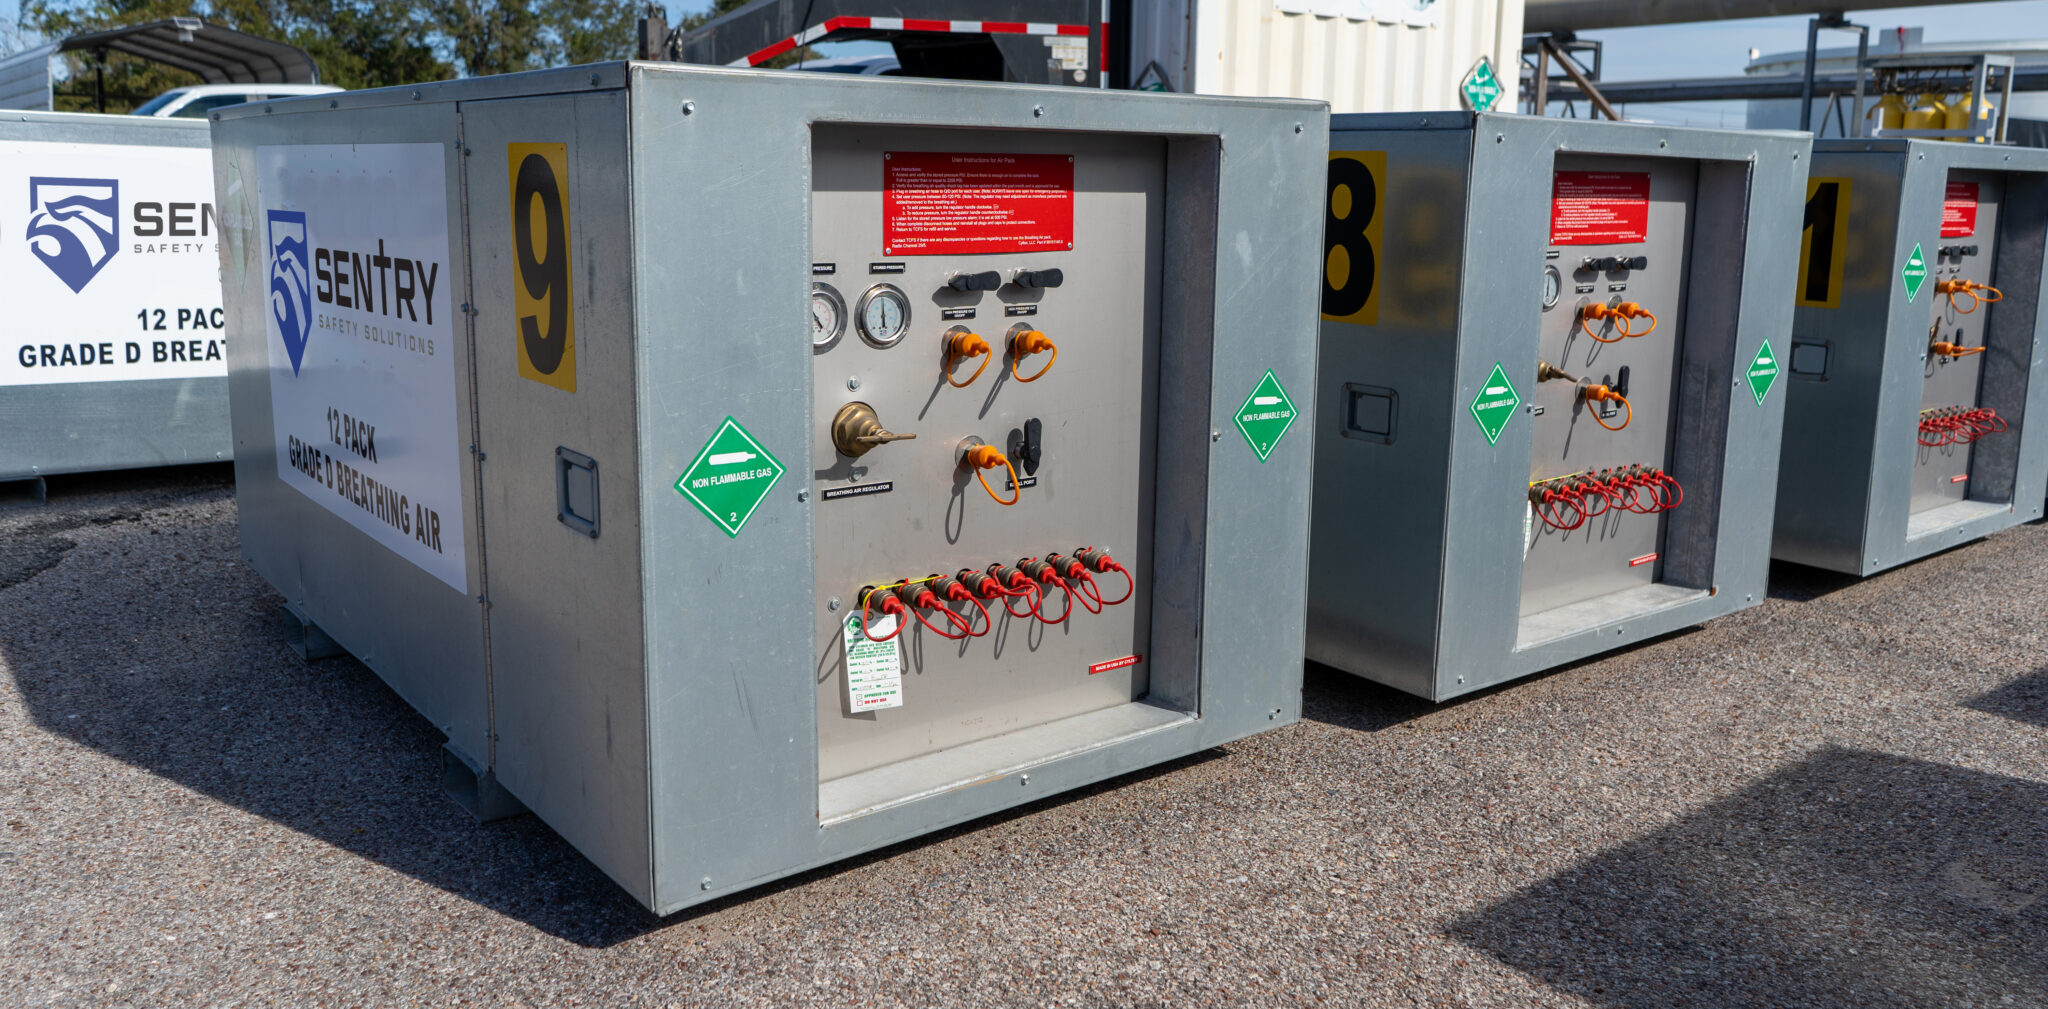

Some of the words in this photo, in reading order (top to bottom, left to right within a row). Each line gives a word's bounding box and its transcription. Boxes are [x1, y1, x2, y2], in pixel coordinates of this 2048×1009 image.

[134, 244, 203, 255] SAFETY
[1320, 157, 1376, 316] 8
[1803, 182, 1839, 302] 1
[514, 153, 568, 375] 9
[315, 239, 438, 325] SENTRY
[138, 308, 167, 331] 12
[178, 308, 224, 330] PAC
[319, 314, 358, 336] SAFETY
[364, 325, 434, 357] SOLUTIONS
[19, 342, 114, 368] GRADE
[126, 342, 141, 364] D
[1254, 411, 1280, 420] FLAMMABLE
[1281, 410, 1290, 418] GAS
[1486, 400, 1506, 409] FLAMMABLE
[1507, 398, 1515, 406] GAS
[327, 406, 341, 446] 12
[344, 413, 378, 464] PACK
[693, 478, 709, 488] NON
[711, 470, 755, 486] FLAMMABLE
[756, 467, 772, 478] GAS
[289, 434, 323, 484] GRADE
[325, 454, 334, 489] D
[336, 460, 410, 535] BREATHING
[416, 503, 442, 555] AIR
[826, 489, 853, 497] BREATHING
[730, 512, 737, 522] 2
